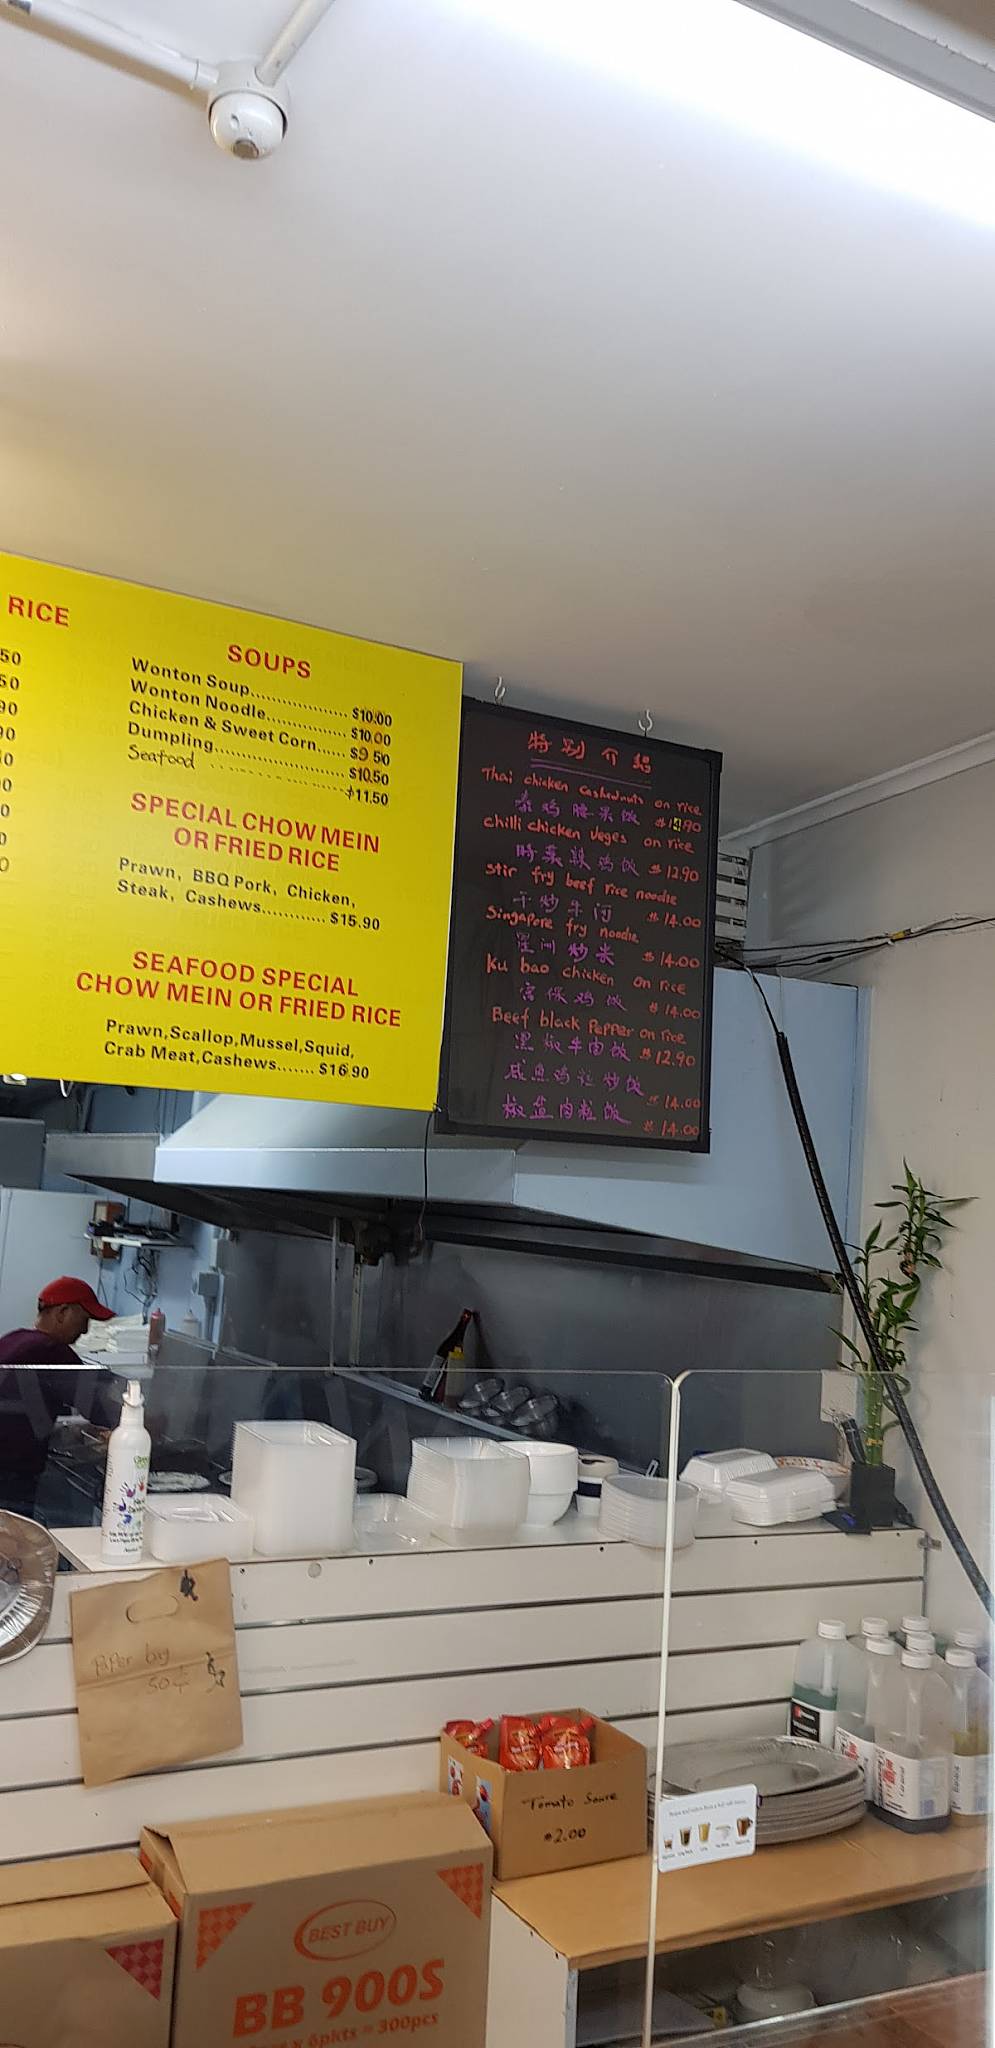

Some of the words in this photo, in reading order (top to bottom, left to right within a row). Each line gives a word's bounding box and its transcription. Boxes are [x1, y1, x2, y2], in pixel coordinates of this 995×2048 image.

[8, 596, 69, 627] RICE
[227, 644, 312, 679] SOUPS
[130, 678, 200, 707] Wonton
[205, 695, 266, 721] Noodle
[132, 656, 201, 686] Wonton
[352, 707, 392, 727] $10.00
[128, 721, 214, 754] Dumpling
[129, 701, 199, 730] Chicken
[204, 715, 218, 731] &
[221, 719, 275, 744] Sweet
[279, 731, 317, 752] Corn
[128, 744, 195, 770] Seafood
[482, 767, 513, 784] Thai
[524, 773, 569, 792] chicken
[655, 799, 671, 809] on
[131, 792, 237, 829] SPECIAL
[242, 812, 317, 841] CHOW
[321, 828, 380, 854] MEIN
[527, 820, 580, 840] chicken
[643, 837, 661, 848] on
[668, 839, 695, 854] rice
[173, 827, 210, 849] OR
[215, 834, 283, 863] FRIED
[288, 848, 340, 872] RICE
[119, 856, 182, 881] Prawn,
[193, 868, 229, 888] BBQ
[234, 875, 277, 896] Pork,
[287, 883, 356, 909] Chicken,
[532, 866, 555, 886] fry
[566, 873, 596, 895] beef
[604, 884, 628, 899] rice
[636, 889, 678, 906] noodle
[117, 880, 175, 901] Steak,
[329, 911, 380, 932] $15.90
[566, 920, 587, 938] fry
[600, 926, 640, 944] noodle
[133, 950, 255, 984] SEAFOOD
[262, 968, 359, 997] SPECIAL
[486, 953, 508, 973] Ku
[520, 956, 550, 974] bao
[562, 966, 614, 986] chicken
[659, 979, 686, 995] rice
[76, 972, 160, 1000] CHOW
[167, 983, 233, 1009] MEIN
[238, 991, 274, 1013] OR
[279, 996, 346, 1022] FRIED
[351, 1005, 402, 1028] RICE
[491, 1006, 530, 1029] Beef
[540, 1009, 581, 1031] black
[661, 1031, 687, 1045] rice
[104, 1040, 146, 1060] Crab
[522, 1796, 575, 1811] Tomato
[583, 1792, 618, 1805] Sauce
[307, 1922, 351, 1943] BEST
[354, 1915, 392, 1935] BUY
[232, 1986, 305, 2038] BB
[321, 1959, 446, 2018] 900S
[378, 2012, 439, 2034] 300pcs
